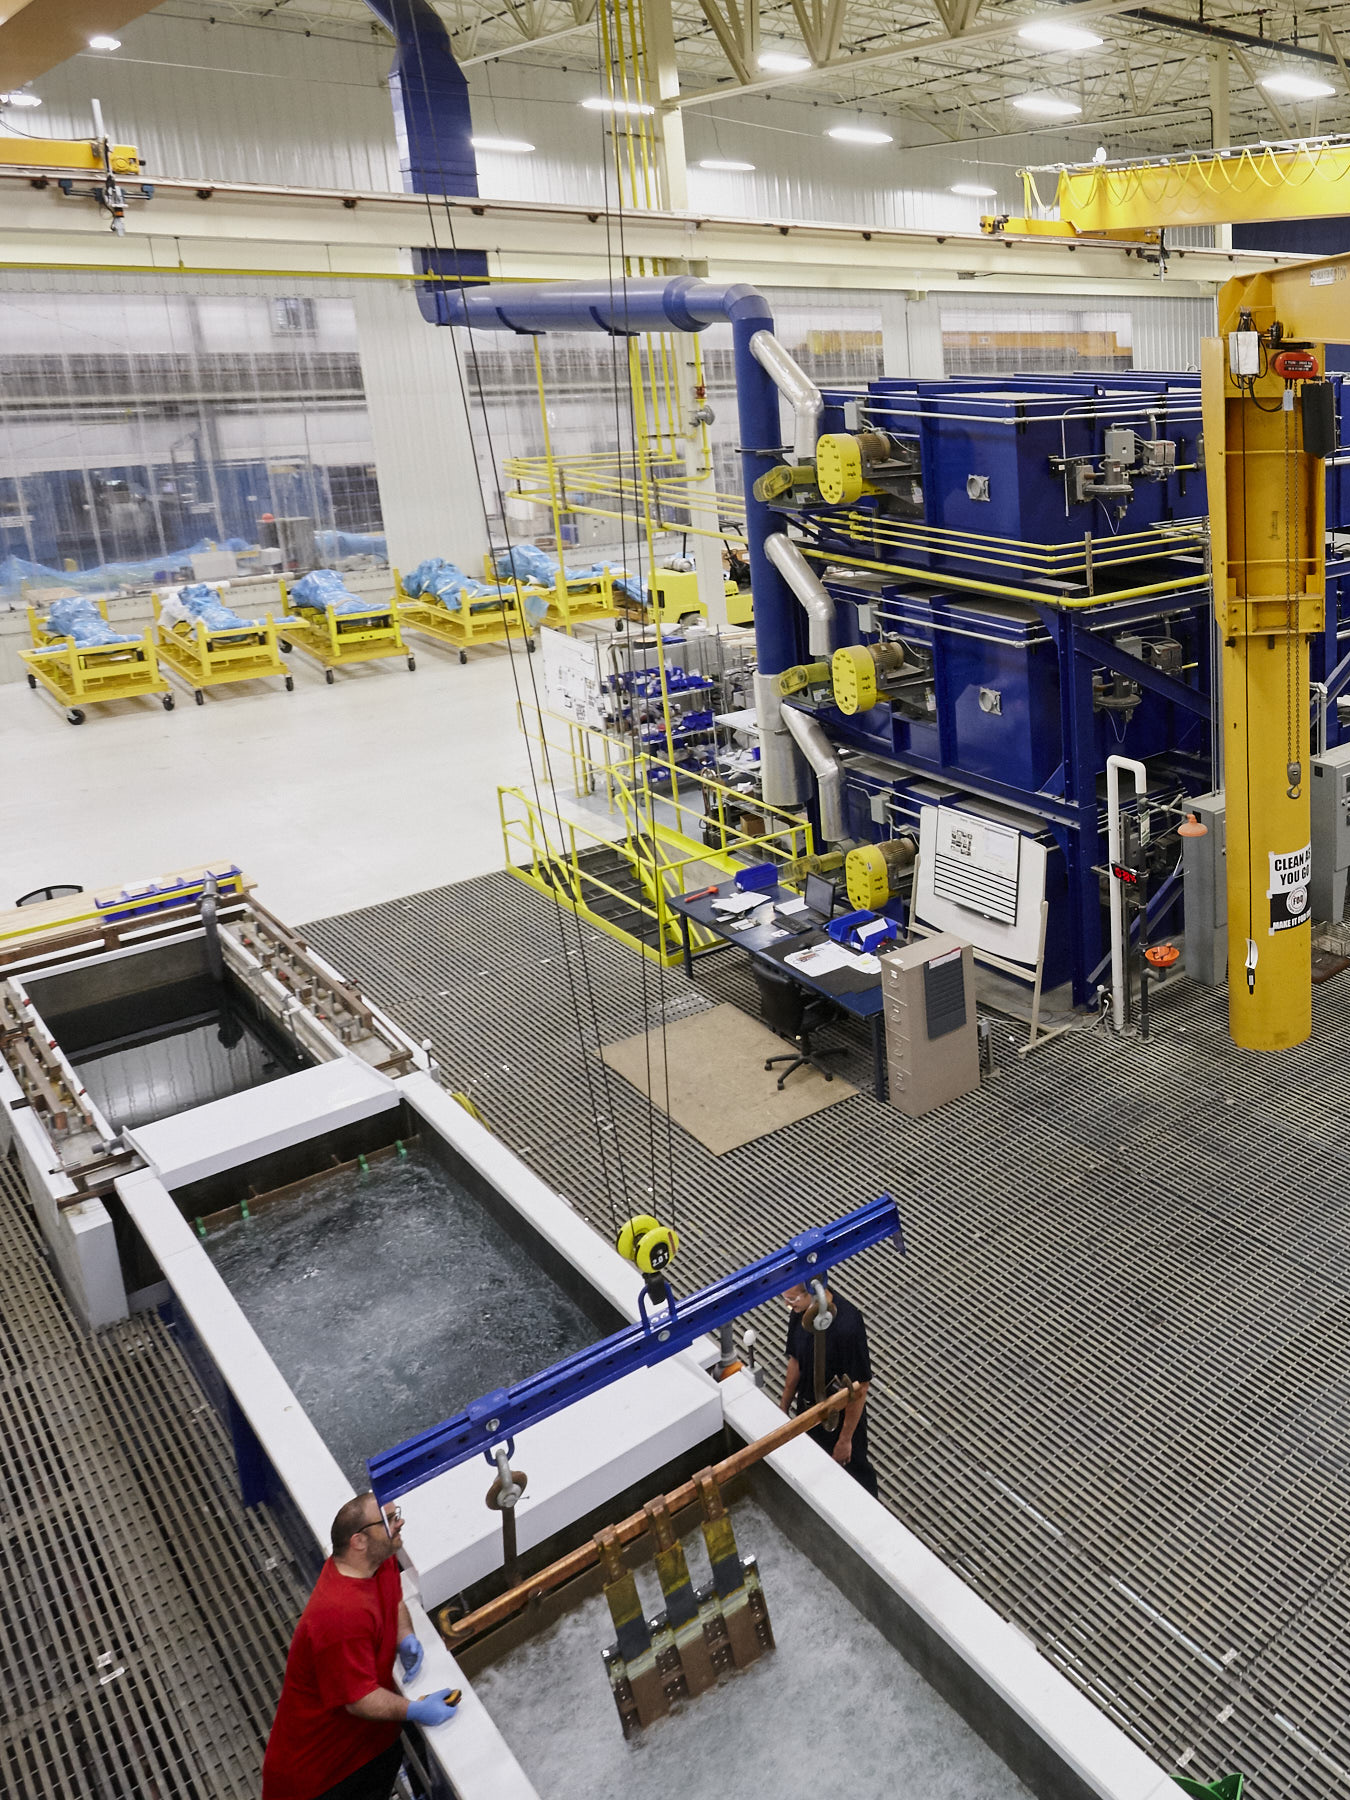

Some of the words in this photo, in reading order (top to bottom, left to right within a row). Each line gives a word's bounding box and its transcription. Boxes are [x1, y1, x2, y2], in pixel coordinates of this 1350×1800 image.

[1274, 853, 1304, 872] CLEAN
[1280, 869, 1300, 886] YOU
[1302, 864, 1309, 880] GO
[1272, 919, 1292, 930] MAKE
[1291, 917, 1298, 927] IT
[664, 1252, 668, 1260] T
